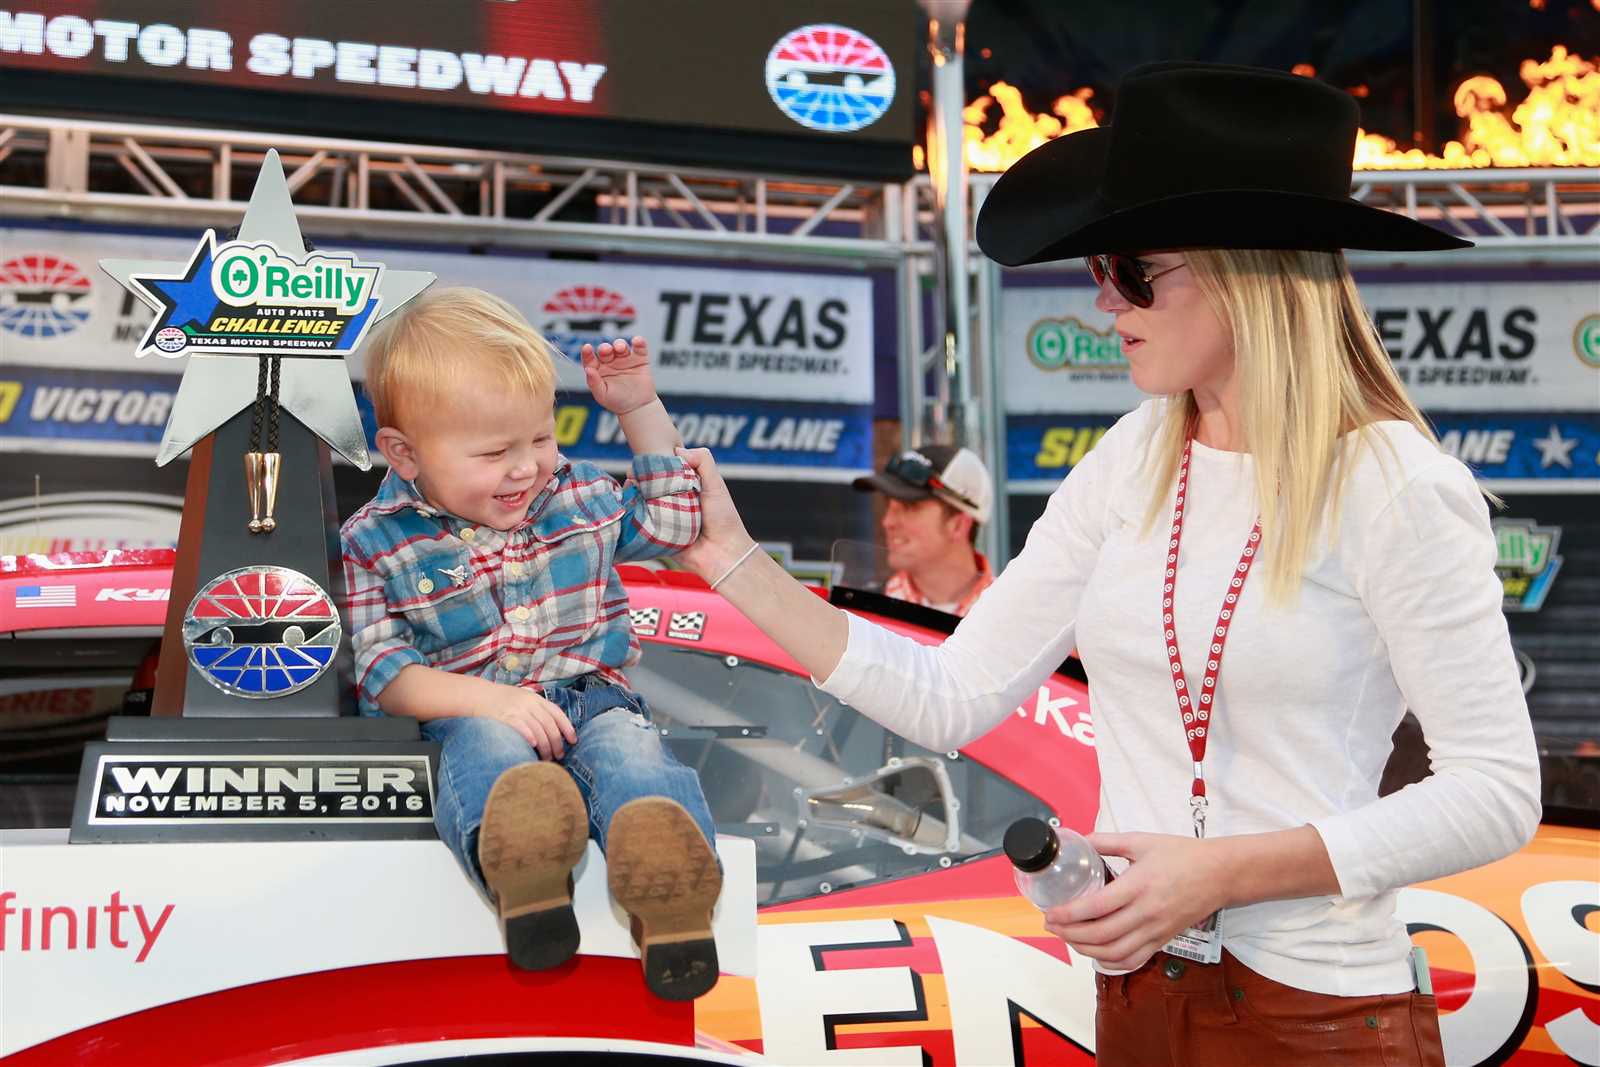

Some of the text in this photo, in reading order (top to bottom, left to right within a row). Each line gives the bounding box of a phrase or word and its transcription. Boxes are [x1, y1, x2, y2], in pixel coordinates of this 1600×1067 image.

[0, 11, 607, 102] MOTOR SPEEDWAY
[220, 255, 365, 307] O'Reilly
[210, 317, 344, 335] CHALLENGE
[256, 308, 325, 317] AUTO PARTS
[659, 291, 849, 350] TEXAS
[190, 337, 333, 348] TEXAS MOTOR SPEEDWAY
[1374, 307, 1538, 361] EXAS
[659, 351, 844, 375] MOTOR SPEEDWAY
[30, 386, 177, 427] VICTOR
[748, 414, 844, 451] LANE
[1439, 429, 1515, 463] ANE
[1034, 686, 1096, 747] Ka
[111, 767, 416, 793] WINNER
[106, 795, 423, 813] NOVEMBER 5, 2016
